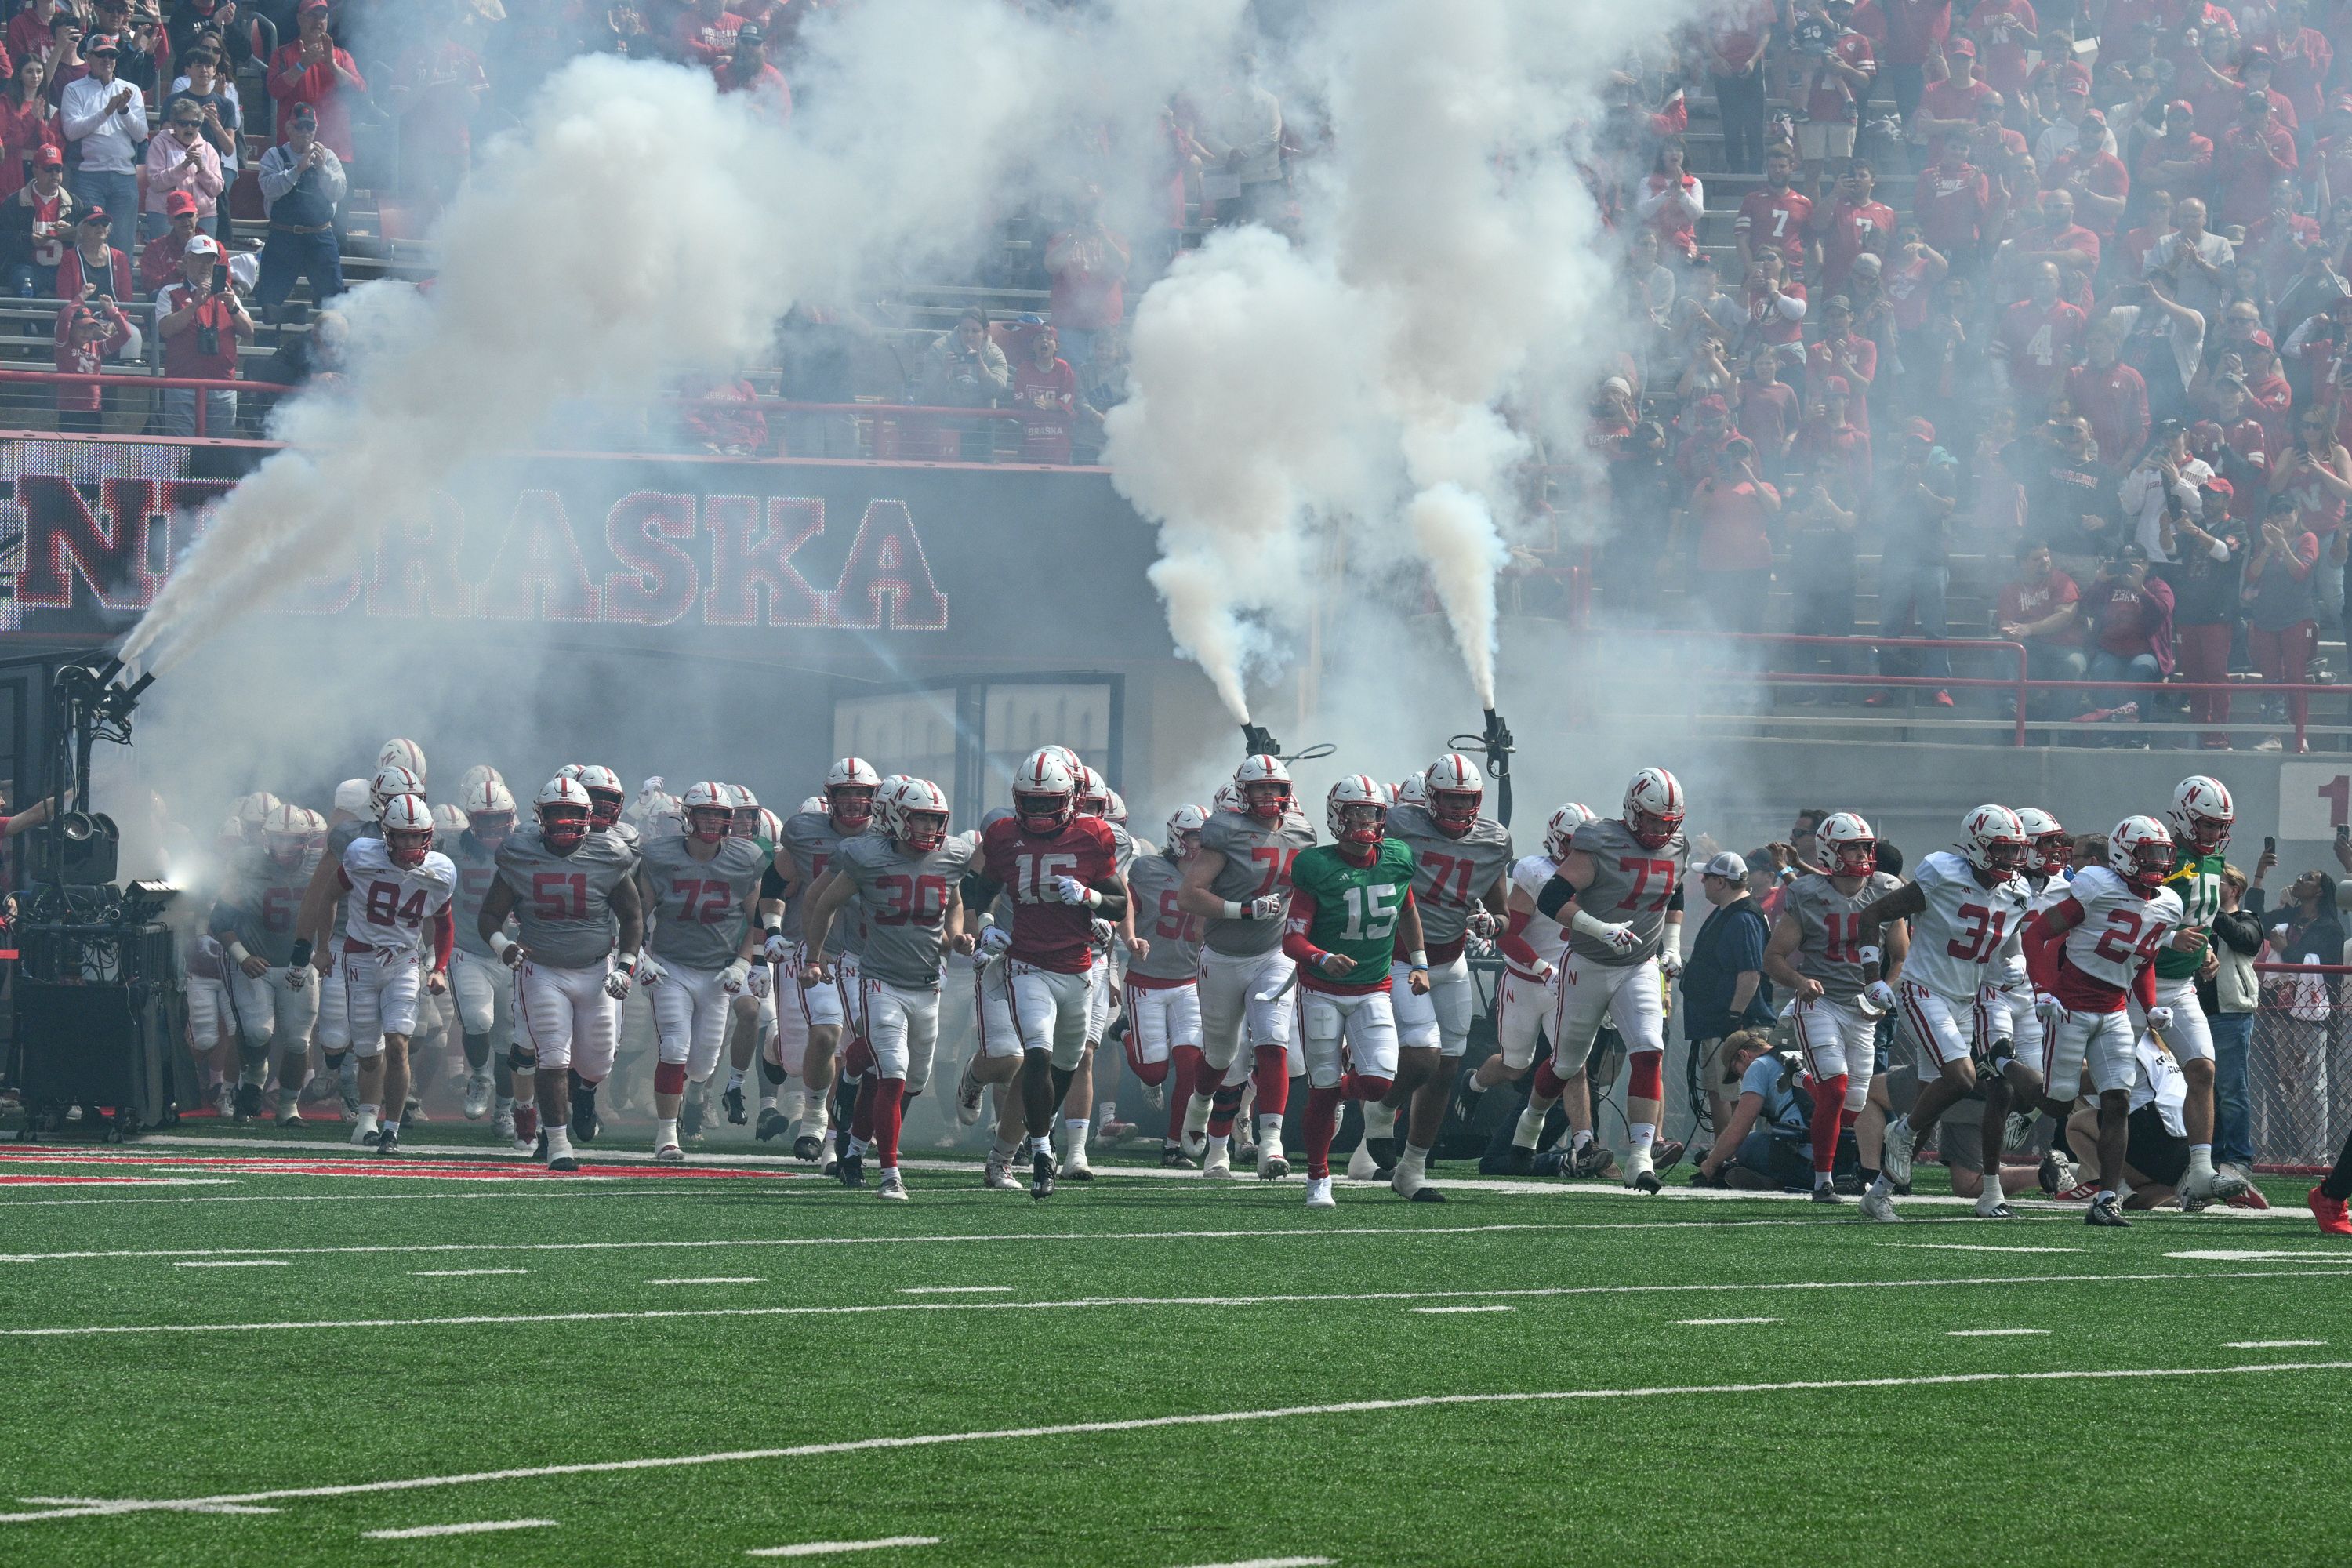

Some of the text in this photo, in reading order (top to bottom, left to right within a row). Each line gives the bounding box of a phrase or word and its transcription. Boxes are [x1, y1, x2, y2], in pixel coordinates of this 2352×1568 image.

[1773, 209, 1789, 237] 7
[203, 239, 211, 248] N
[2027, 324, 2053, 365] 4
[14, 473, 950, 632] NRASKA
[2307, 628, 2312, 638] N
[895, 786, 909, 801] N
[1634, 779, 1651, 795] N
[2186, 786, 2202, 804] N
[2318, 775, 2350, 828] 1
[1552, 811, 1566, 827] N
[1973, 814, 1990, 831] N
[1824, 820, 1835, 837] N
[2117, 823, 2131, 839] N
[1015, 853, 1078, 905] 16
[1420, 851, 1474, 908] 71
[1617, 857, 1675, 912] 77
[366, 880, 428, 928] 84
[533, 873, 590, 921] 51
[672, 878, 731, 925] 72
[874, 874, 947, 927] 30
[2188, 872, 2220, 927] 10
[1339, 883, 1398, 941] 15
[1285, 917, 1308, 935] N
[1947, 902, 2007, 964] 31
[2094, 908, 2167, 969] 24
[456, 953, 463, 964] N
[350, 967, 358, 982] N
[525, 964, 533, 978] N
[785, 964, 794, 979] N
[846, 966, 855, 978] N
[1018, 964, 1028, 975] N
[1202, 964, 1208, 979] N
[1568, 970, 1577, 985] N
[872, 979, 881, 993] N
[1138, 987, 1147, 997] N
[1918, 985, 1929, 998] N
[1987, 986, 1995, 1000] N
[1506, 989, 1514, 1003] N
